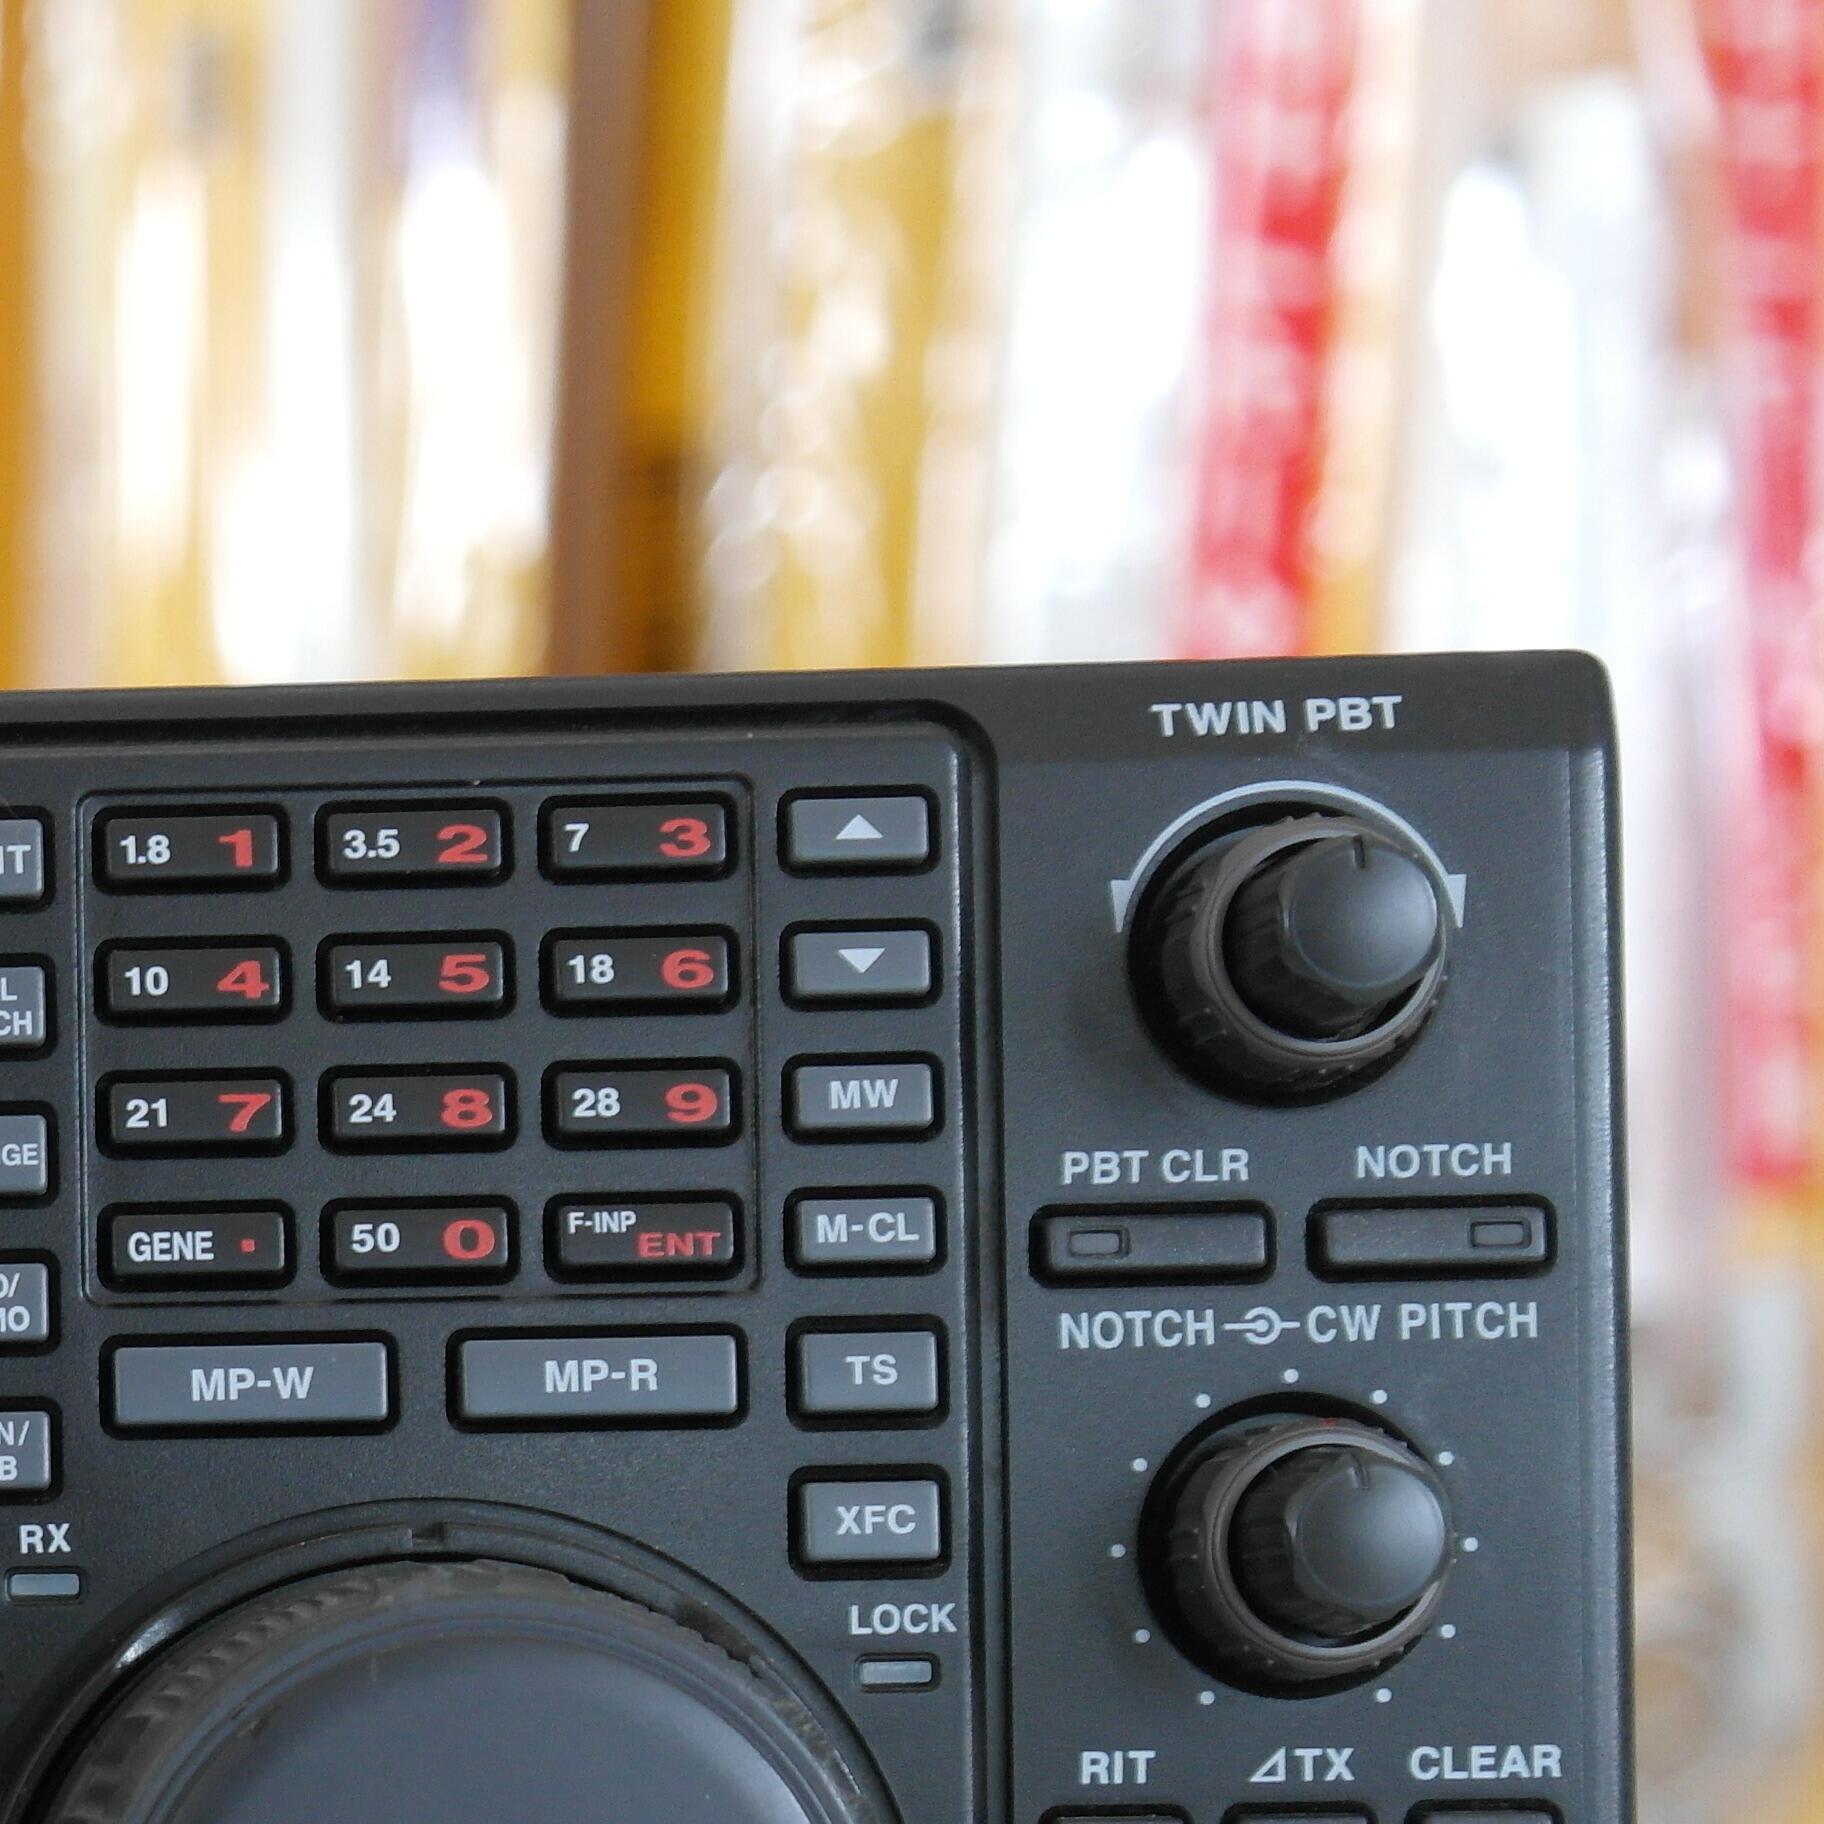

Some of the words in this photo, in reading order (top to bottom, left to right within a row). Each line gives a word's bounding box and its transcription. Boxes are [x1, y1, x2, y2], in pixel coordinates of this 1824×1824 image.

[1150, 699, 1287, 737] TWIN
[1305, 695, 1402, 732] PBT
[119, 834, 171, 865] 1.8
[219, 829, 253, 868] 1
[343, 828, 400, 859] 3.5
[438, 824, 488, 863] 2
[565, 823, 590, 852] 7
[660, 818, 711, 857] 3
[124, 966, 169, 996] 10
[217, 960, 270, 999] 4
[345, 959, 392, 989] 14
[439, 954, 490, 993] 5
[568, 954, 615, 984] 18
[662, 949, 714, 989] 6
[126, 1098, 167, 1128] 21
[218, 1093, 271, 1132] 7
[349, 1093, 397, 1123] 24
[441, 1089, 493, 1129] 8
[573, 1087, 621, 1117] 28
[665, 1083, 718, 1123] 9
[830, 1078, 899, 1110] MW
[1063, 1150, 1149, 1185] PBT
[1161, 1148, 1249, 1183] CLR
[1356, 1142, 1512, 1179] NOTCH
[128, 1230, 215, 1262] GENE
[351, 1222, 400, 1253] 50
[443, 1219, 496, 1260] 0
[568, 1210, 637, 1234] F-INP
[638, 1231, 721, 1258] ENT
[816, 1212, 920, 1244] M-CL
[1059, 1308, 1215, 1350] NOTCH
[1307, 1304, 1382, 1343] CW
[1400, 1301, 1538, 1340] PITCH
[191, 1366, 314, 1402] MP-W
[544, 1358, 658, 1393] MP-R
[845, 1353, 898, 1385] TS
[19, 1523, 71, 1554] RX
[836, 1504, 916, 1535] XFC
[850, 1602, 957, 1635] LOCK
[1081, 1750, 1156, 1785] RIT
[1410, 1744, 1562, 1781] CLEAR
